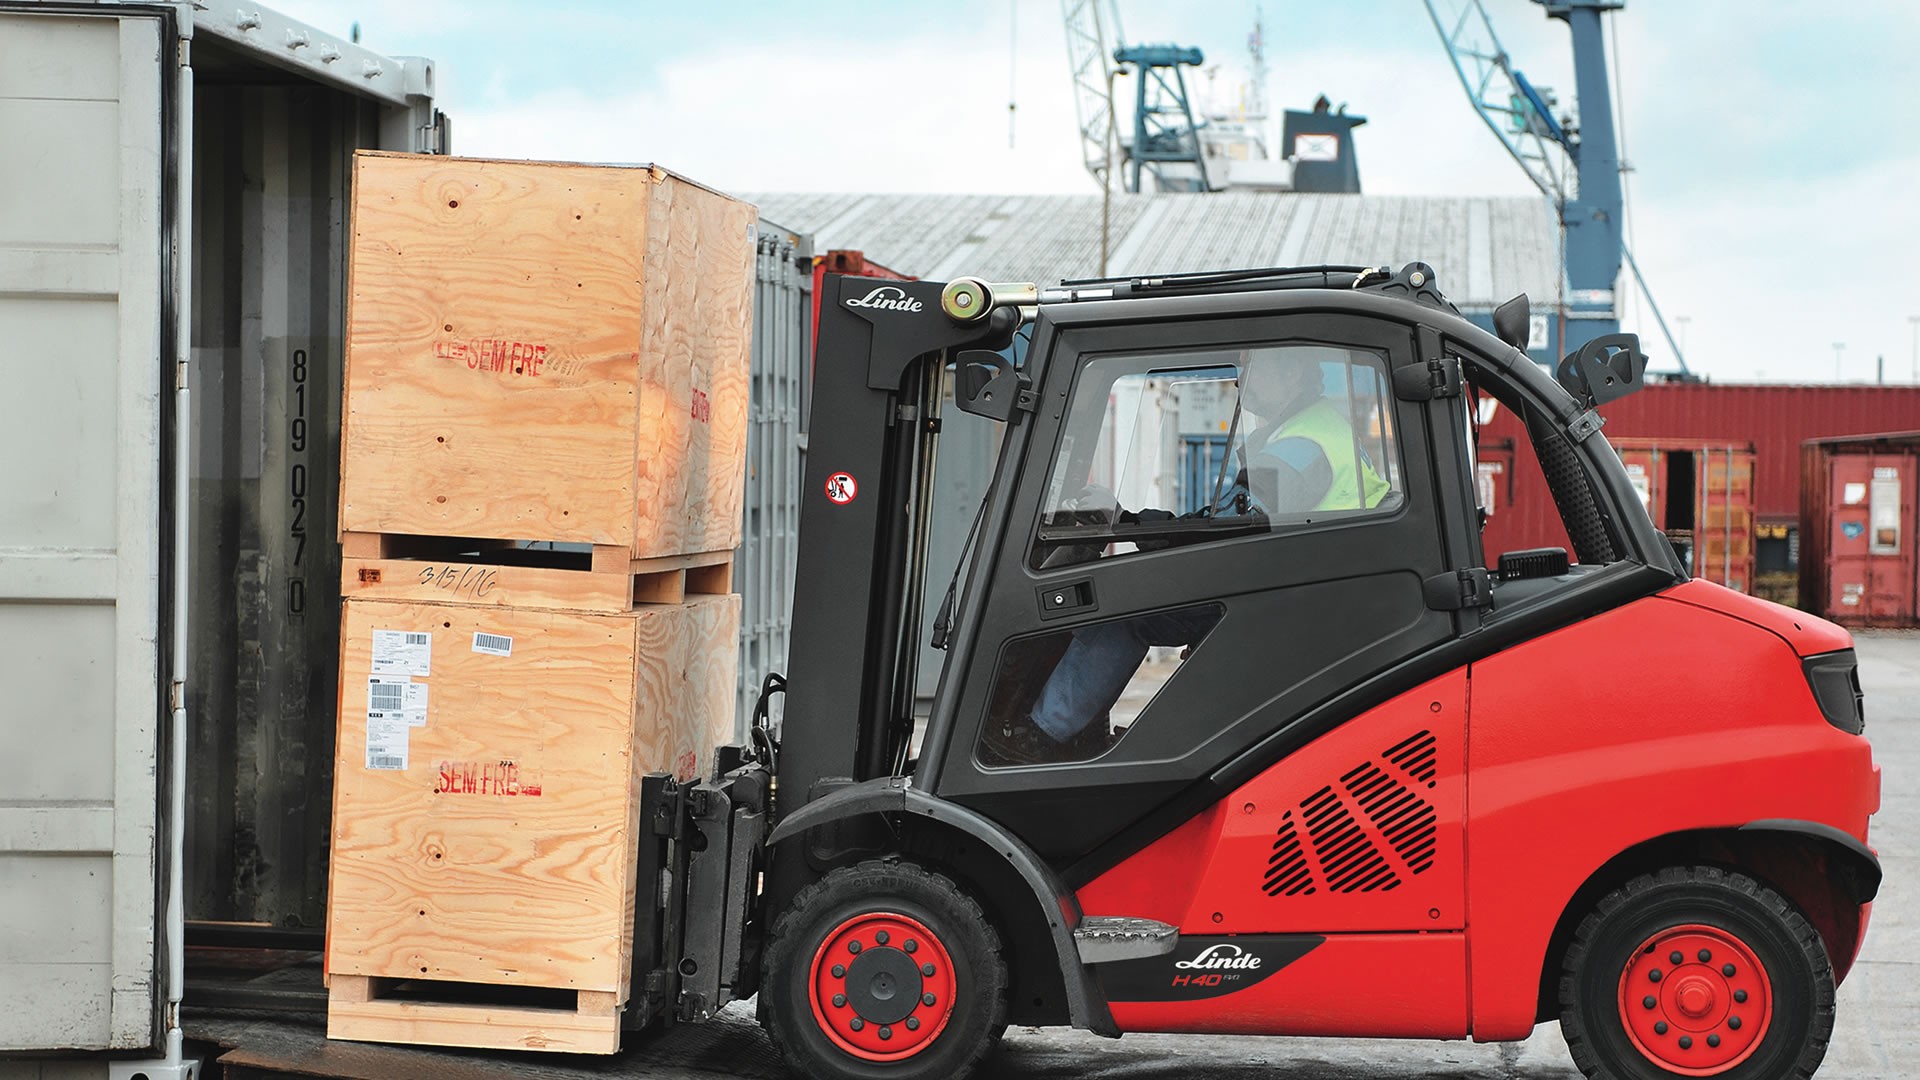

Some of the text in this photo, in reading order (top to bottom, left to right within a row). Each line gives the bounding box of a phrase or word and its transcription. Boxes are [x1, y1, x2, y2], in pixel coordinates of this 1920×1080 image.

[846, 286, 923, 312] Linde
[467, 338, 507, 373] SEM
[292, 350, 307, 452] 819
[291, 464, 306, 567] 027
[439, 760, 478, 794] SEM
[1175, 944, 1261, 970] Linde
[1172, 975, 1191, 986] H
[1192, 974, 1222, 986] 40
